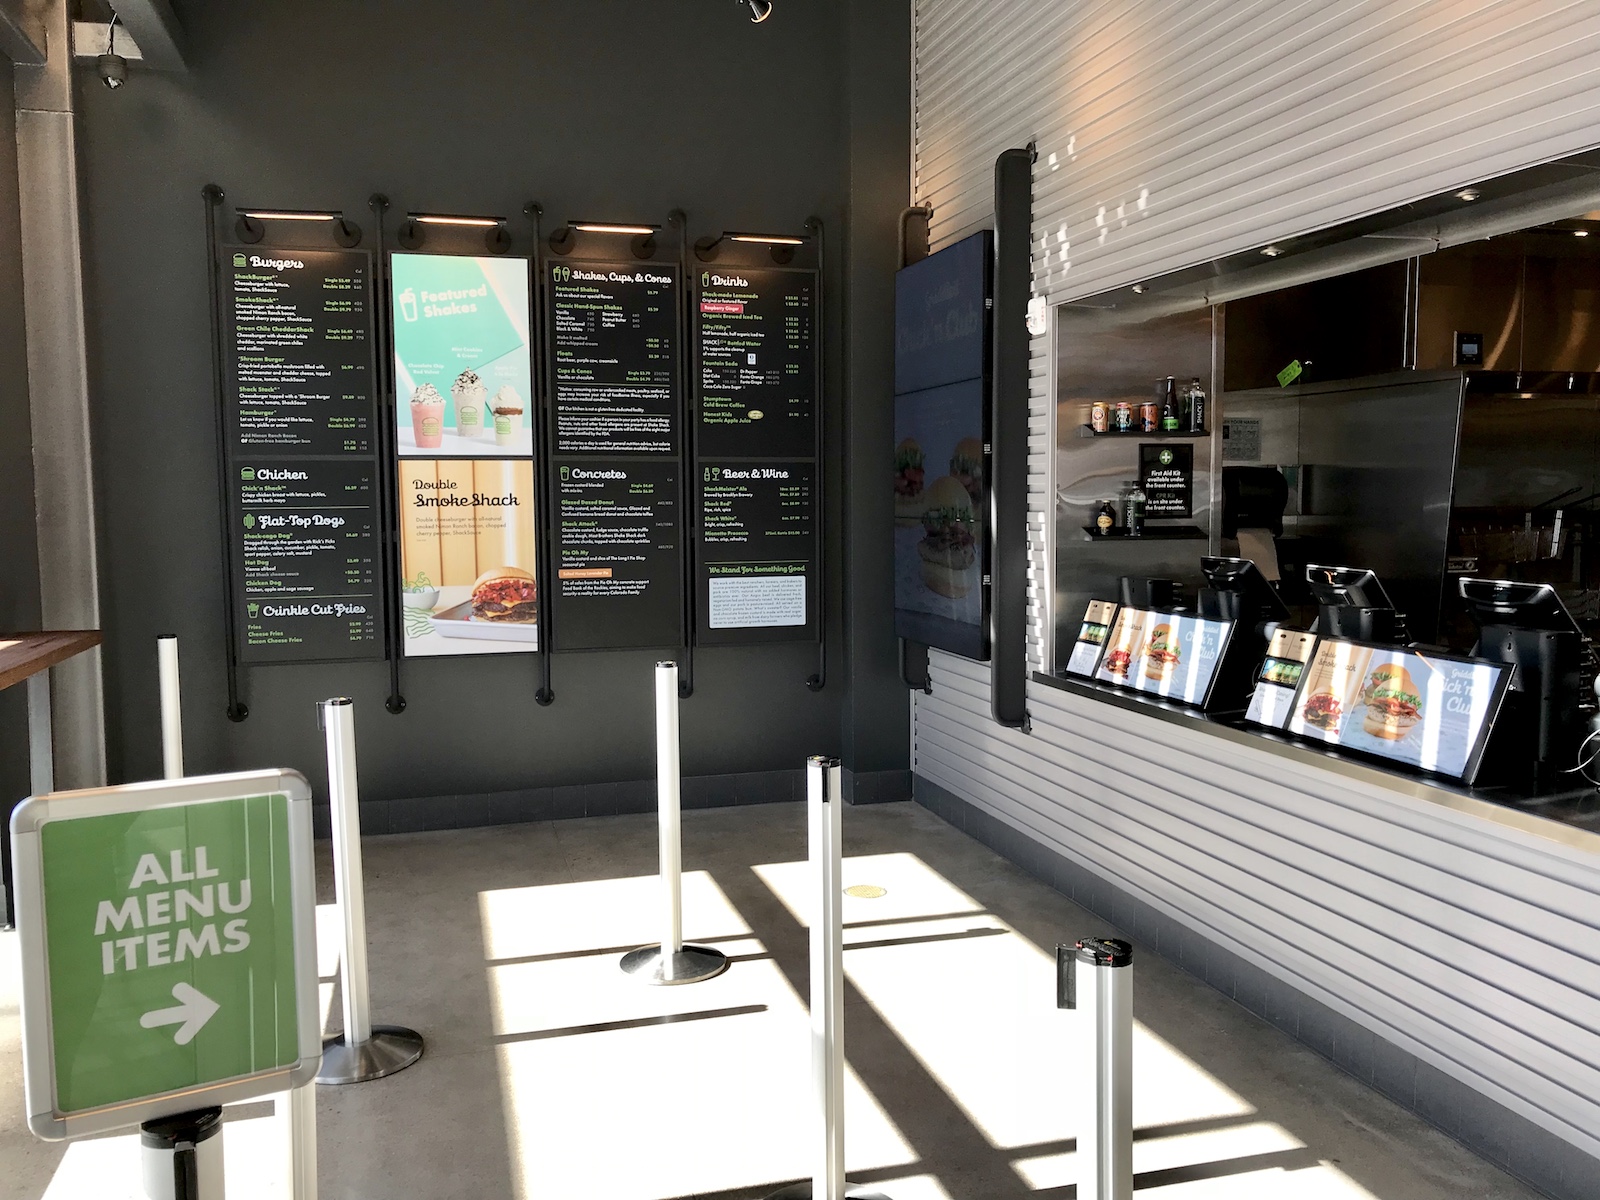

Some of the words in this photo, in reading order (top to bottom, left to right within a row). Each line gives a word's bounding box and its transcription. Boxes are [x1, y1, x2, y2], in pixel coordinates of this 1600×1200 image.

[250, 256, 304, 271] Burgers
[572, 270, 608, 282] Shakes,
[609, 272, 633, 284] Cups,
[635, 274, 644, 282] &
[645, 274, 672, 283] Cones
[711, 275, 748, 287] Drinks
[421, 285, 487, 302] Featured
[424, 302, 477, 318] Shakes
[257, 469, 308, 480] Chicken
[572, 468, 626, 479] Concretes
[723, 469, 749, 479] Beer
[751, 469, 760, 478] &
[761, 469, 789, 478] Wine
[413, 479, 457, 490] Double
[258, 515, 311, 529] Flat-Top
[312, 515, 345, 528] Dogs
[263, 605, 309, 616] Crinkle
[311, 604, 333, 615] Cut
[334, 604, 366, 617] Fries
[1447, 696, 1470, 714] Clu
[129, 846, 219, 889] ALL
[94, 879, 251, 936] MENU
[102, 918, 250, 975] ITEMS
